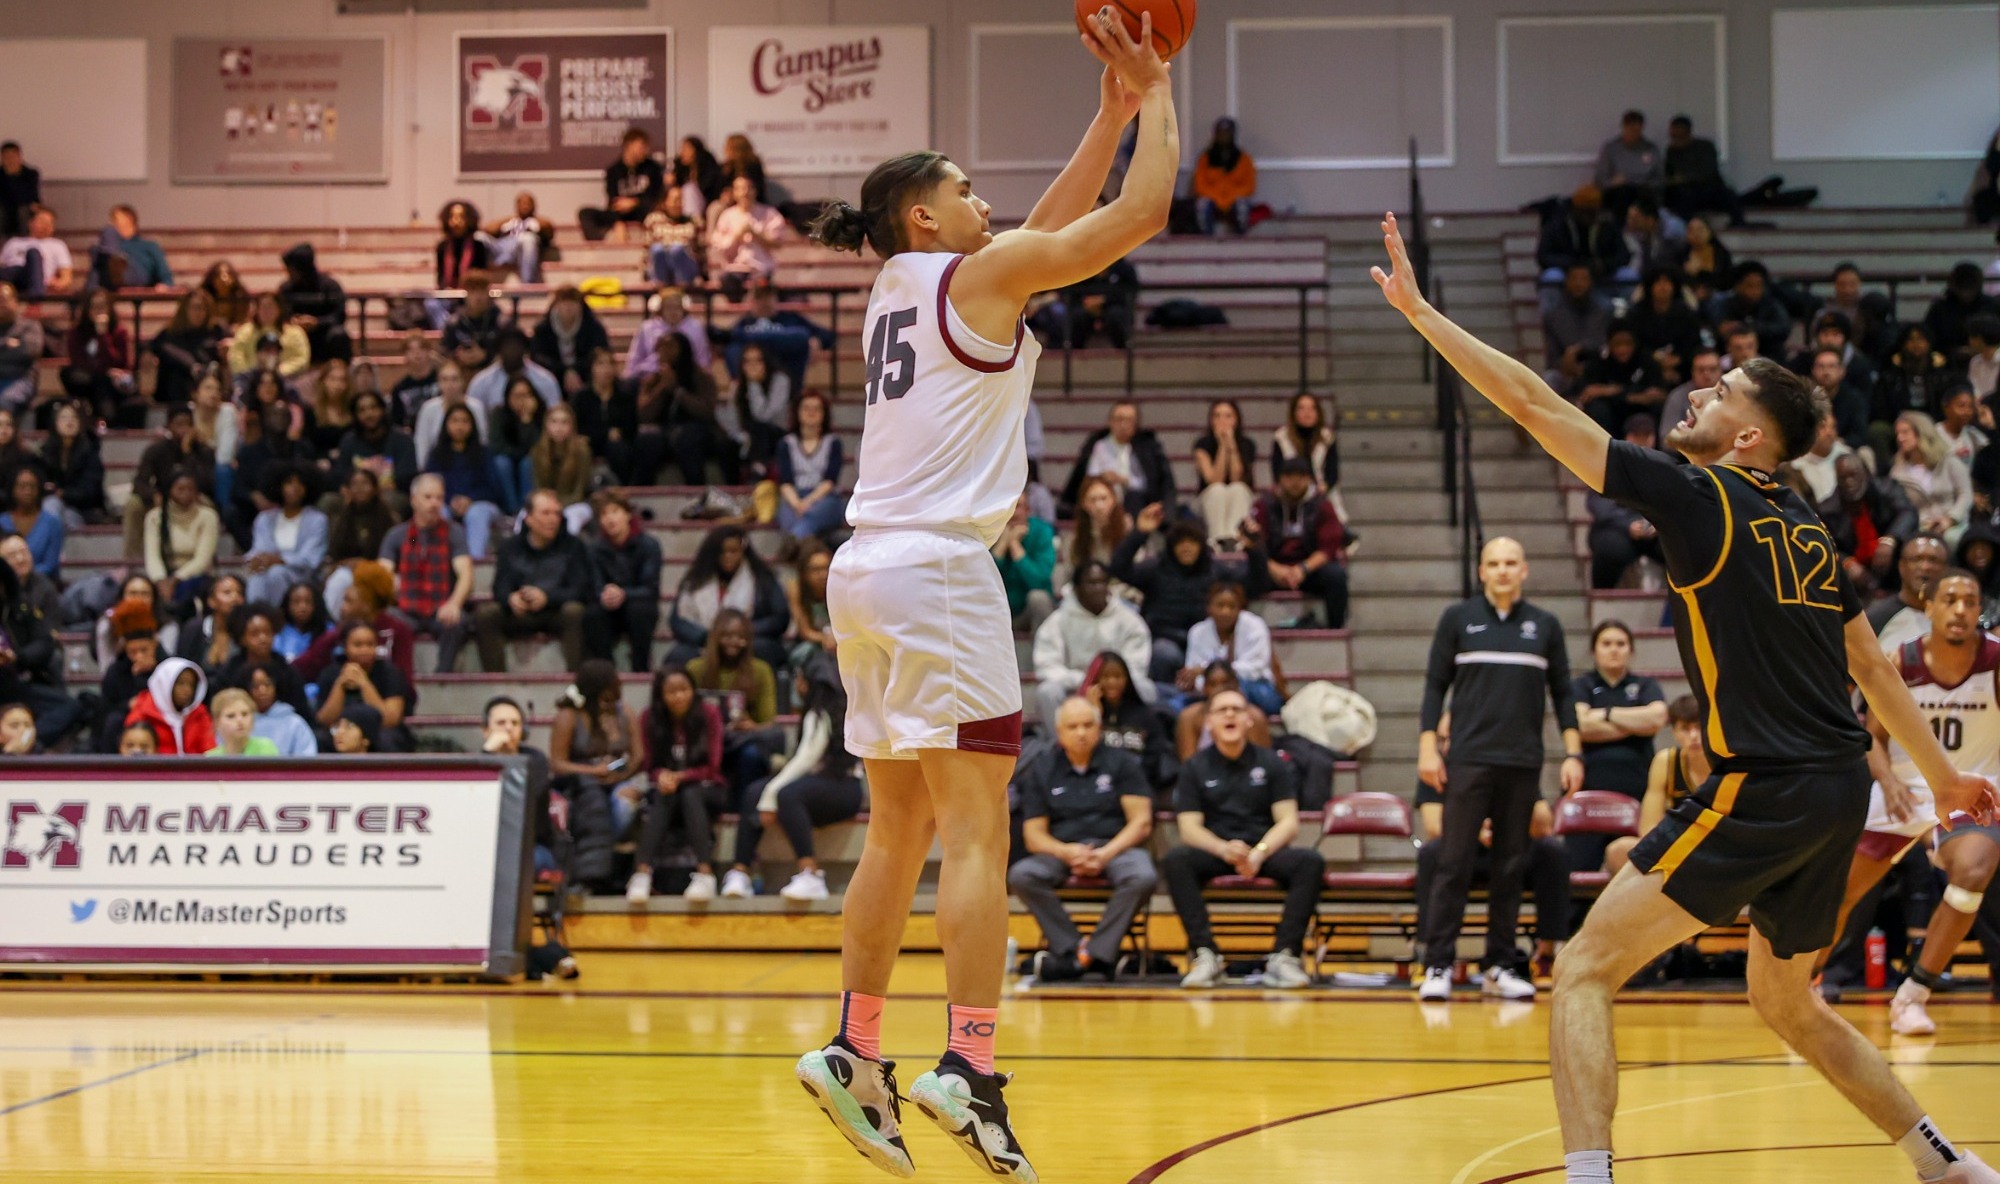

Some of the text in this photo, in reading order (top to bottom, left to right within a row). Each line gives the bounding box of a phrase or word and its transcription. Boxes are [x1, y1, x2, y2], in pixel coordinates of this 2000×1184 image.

[752, 35, 883, 97] Campus
[803, 77, 874, 114] Store
[866, 305, 918, 406] 45
[1749, 516, 1844, 612] 12
[1930, 716, 1963, 751] 10
[104, 804, 432, 835] McMASTER
[108, 843, 422, 868] MARAUDERS
[107, 898, 348, 930] @McMasterSports
